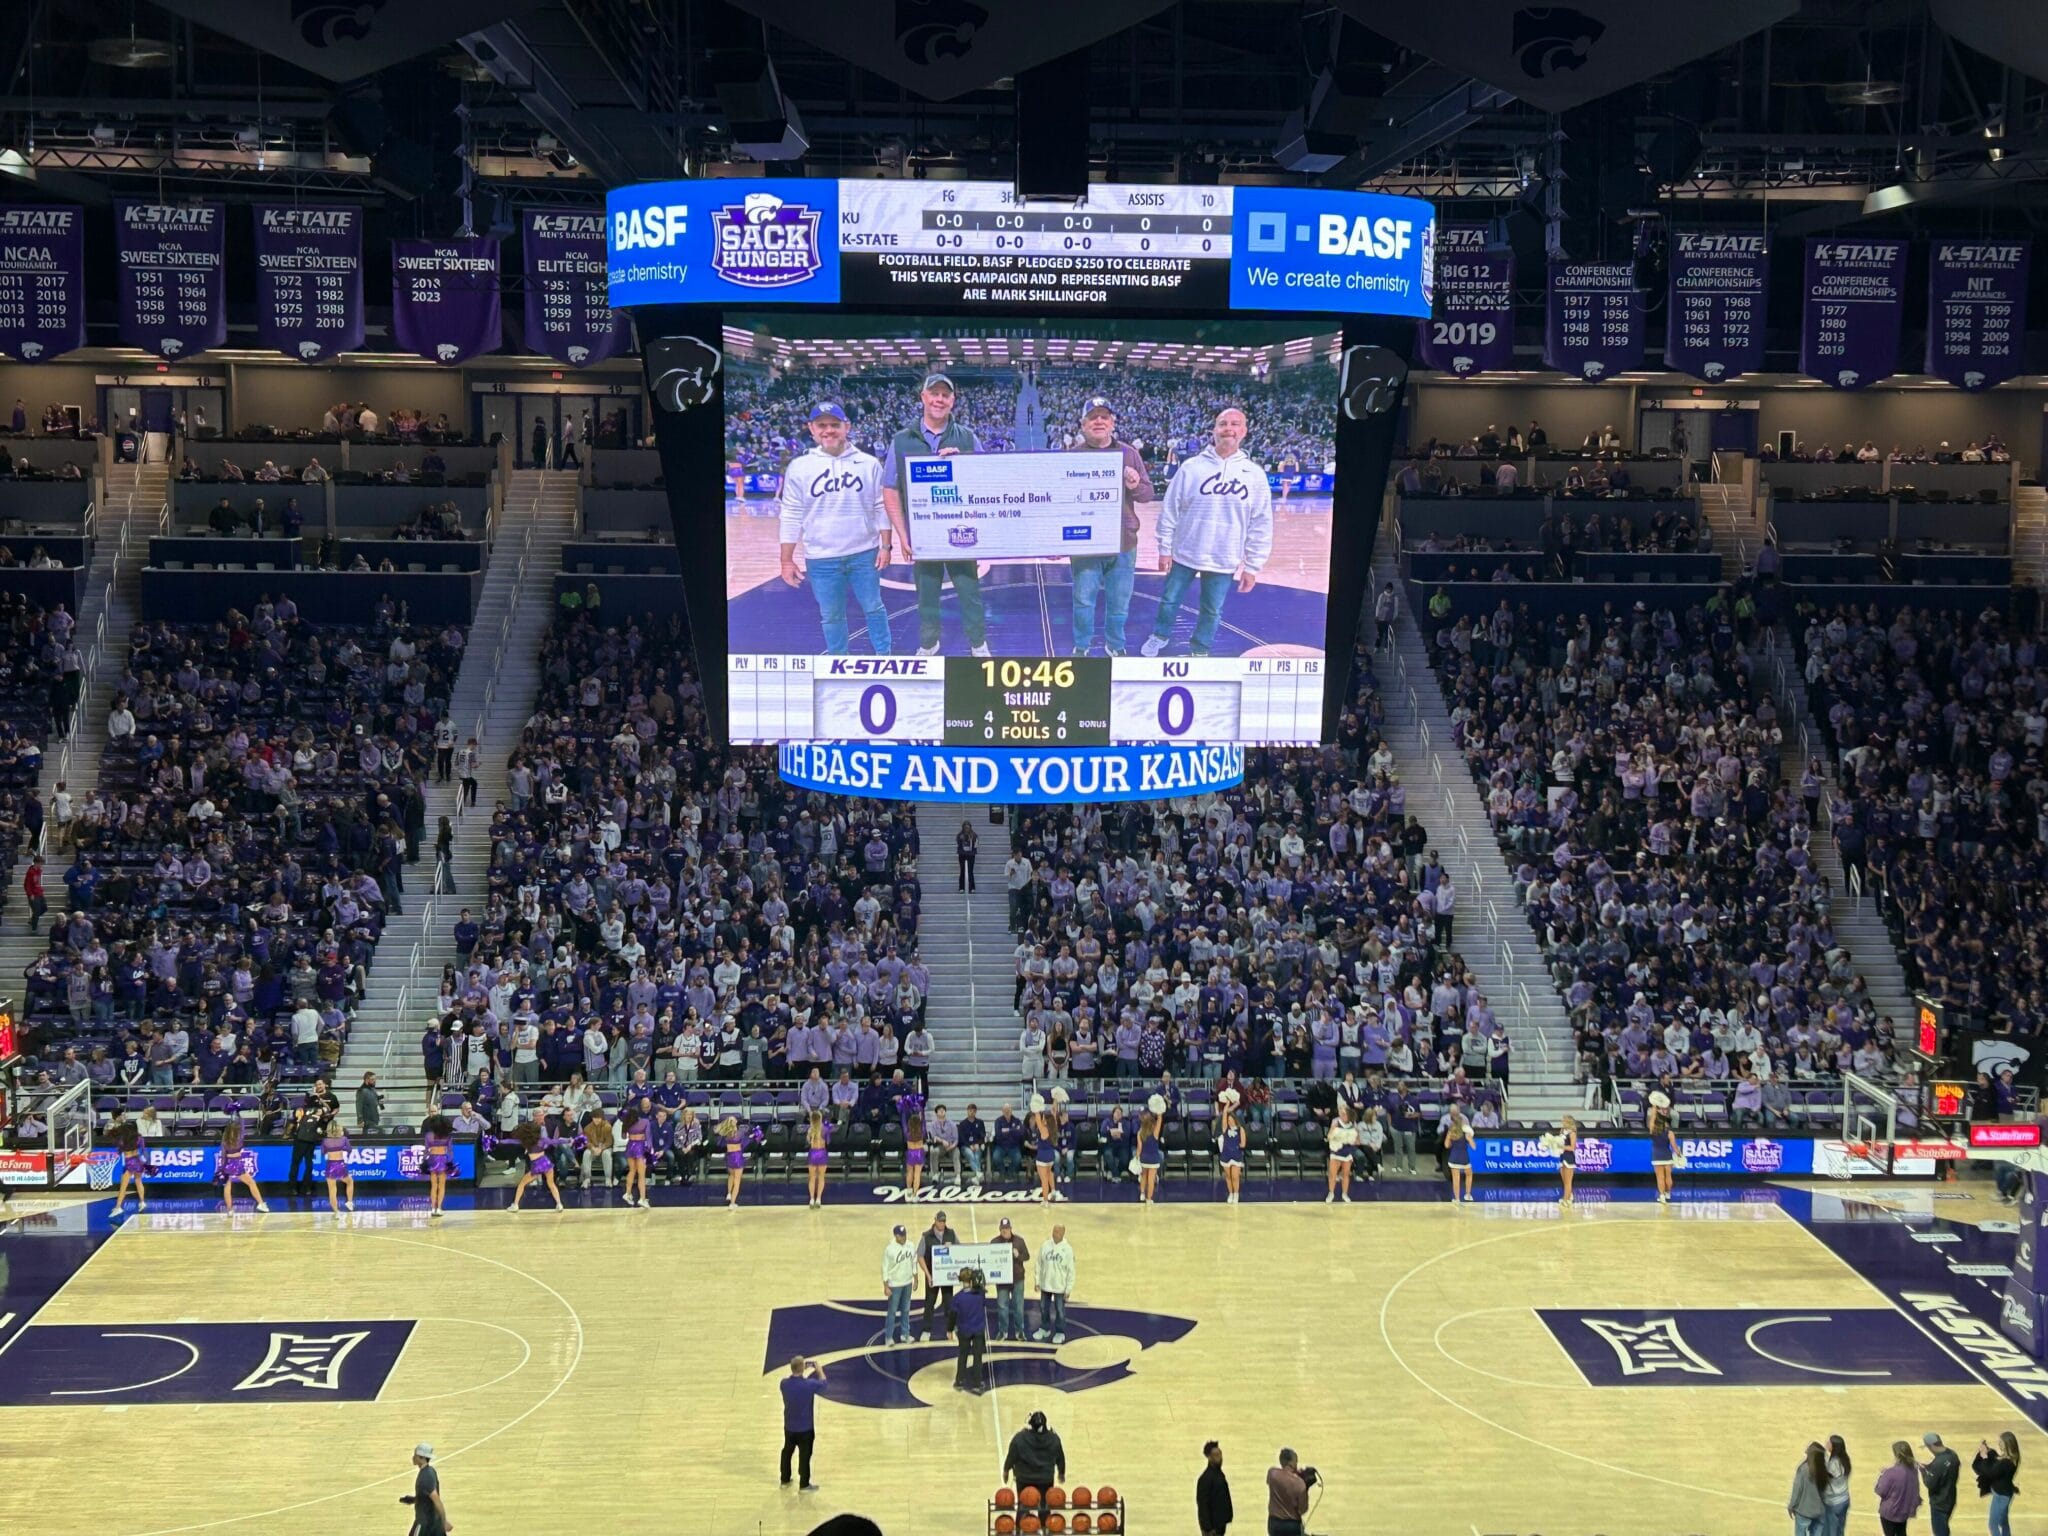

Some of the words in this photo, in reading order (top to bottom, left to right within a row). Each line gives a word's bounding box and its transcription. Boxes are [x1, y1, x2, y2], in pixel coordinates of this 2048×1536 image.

[942, 190, 955, 202] FG
[1128, 194, 1165, 206] ASSISTS
[1202, 195, 1214, 207] TO
[124, 205, 215, 224] K-STATE
[263, 210, 352, 227] K-STATE
[615, 205, 688, 251] BASF
[842, 213, 860, 224] KU
[1141, 217, 1151, 231] 0
[1202, 218, 1212, 232] 0
[721, 225, 809, 250] SACK
[842, 233, 898, 246] K-STATE
[1140, 238, 1150, 251] 0
[1202, 239, 1212, 252] 0
[1318, 214, 1412, 260] BASF
[158, 243, 182, 251] NCAA
[1678, 236, 1763, 251] K-STATE
[4, 247, 51, 261] NCAA
[296, 247, 320, 255] NCAA
[434, 249, 458, 257] NCAA
[565, 252, 589, 260] NCAA
[1814, 244, 1899, 261] K-STATE
[1939, 246, 2023, 262] K-STATE
[120, 251, 165, 264] SWEET
[167, 252, 220, 266] SIXTEEN
[259, 254, 302, 268] SWEET
[305, 256, 357, 269] SIXTEEN
[398, 257, 441, 270] SWEET
[443, 258, 495, 271] SIXTEEN
[721, 251, 809, 268] HUNGER
[878, 254, 941, 267] FOOTBALL
[944, 255, 981, 267] FIELD.
[983, 256, 1013, 268] BASF
[1018, 256, 1073, 269] PLEDGED
[1075, 257, 1104, 270] $250
[1106, 258, 1123, 270] TO
[1125, 259, 1191, 271] CELEBRATE
[538, 260, 573, 273] ELITE
[1443, 265, 1469, 278] BIG
[1472, 265, 1490, 278] 12
[1565, 266, 1632, 276] CONFERENCE
[1687, 267, 1754, 277] CONFERENCE
[135, 272, 162, 283] 1951
[178, 273, 205, 284] 1961
[628, 263, 688, 284] chemistry
[890, 270, 918, 283] THIS
[920, 271, 961, 284] YEAR'S
[963, 272, 1028, 285] CAMPAIGN
[1030, 273, 1057, 285] AND
[1061, 274, 1149, 287] REPRESENTING
[1151, 275, 1182, 287] BASF
[36, 276, 65, 287] 2017
[274, 276, 302, 287] 1972
[315, 276, 343, 287] 1981
[1248, 267, 1278, 286] We
[1285, 270, 1341, 289] create
[1346, 271, 1410, 297] chemistry
[1676, 278, 1762, 288] CHAMPIONSHIPS
[1822, 275, 1889, 286] CONFERENCE
[1967, 277, 1994, 291] NIT
[37, 290, 66, 301] 2018
[136, 286, 165, 297] 1956
[178, 287, 207, 298] 1964
[274, 289, 302, 300] 1973
[315, 290, 344, 301] 1982
[412, 291, 441, 302] 2023
[963, 288, 987, 300] ARE
[991, 289, 1026, 301] MARK
[1028, 289, 1107, 302] SHILLINGFOR
[1811, 286, 1897, 297] CHAMPIONSHIPS
[543, 294, 571, 305] 1958
[1563, 296, 1590, 306] 1917
[1603, 296, 1629, 306] 1951
[1685, 297, 1712, 307] 1960
[1724, 297, 1751, 307] 1968
[37, 304, 66, 315] 2019
[136, 300, 165, 311] 1958
[178, 301, 207, 312] 1968
[274, 303, 303, 314] 1975
[316, 304, 344, 315] 1988
[136, 314, 165, 325] 1959
[178, 315, 207, 326] 1970
[543, 308, 572, 319] 1959
[585, 309, 613, 320] 1973
[1563, 309, 1590, 319] 1919
[1602, 309, 1629, 320] 1956
[1684, 310, 1710, 321] 1961
[1723, 311, 1751, 321] 1970
[38, 318, 66, 329] 2023
[274, 317, 303, 328] 1977
[316, 318, 345, 329] 2010
[543, 322, 571, 332] 1961
[585, 323, 613, 333] 1975
[1562, 323, 1590, 333] 1948
[1602, 323, 1629, 333] 1958
[1684, 324, 1710, 334] 1963
[1722, 324, 1750, 334] 1972
[1432, 322, 1496, 345] 2019
[1562, 336, 1589, 346] 1950
[1601, 336, 1629, 347] 1959
[1683, 337, 1710, 347] 1964
[1722, 337, 1749, 347] 1973
[1817, 345, 1845, 355] 2019
[1981, 345, 2009, 356] 2024
[1726, 400, 1740, 409] 22
[1066, 470, 1090, 479] February
[811, 468, 863, 498] Cats
[1200, 470, 1249, 500] Cats
[931, 485, 958, 496] food
[931, 495, 963, 504] bank
[968, 494, 1001, 504] Kansas
[1003, 492, 1025, 504] Food
[1028, 492, 1052, 503] Bank
[932, 511, 963, 520] Thousand
[964, 511, 987, 519] Dollars
[735, 657, 748, 669] PLY
[763, 658, 778, 669] PTS
[792, 658, 806, 670] FLS
[830, 659, 927, 675] K-STATE
[981, 660, 1075, 688] 10:46
[1162, 662, 1189, 677] KU
[1249, 660, 1262, 672] PLY
[1277, 661, 1291, 672] PTS
[1305, 661, 1318, 673] FLS
[859, 684, 897, 735] 0
[1023, 692, 1051, 706] HALF
[1158, 686, 1194, 736] 0
[946, 720, 973, 728] BONUS
[984, 710, 994, 723] 4
[1011, 711, 1040, 723] TOL
[1057, 710, 1067, 723] 4
[1079, 720, 1107, 728] BONUS
[984, 726, 994, 739] 0
[1002, 727, 1050, 739] FOULS
[1057, 727, 1067, 739] 0
[812, 746, 892, 789] BASF
[900, 754, 999, 793] AND
[1010, 756, 1130, 795] YOUR
[1140, 746, 1239, 791] KANSAS
[703, 1041, 715, 1057] 31
[1683, 1140, 1733, 1157] BASF
[150, 1150, 204, 1166] BASF
[164, 1169, 203, 1179] chemistry
